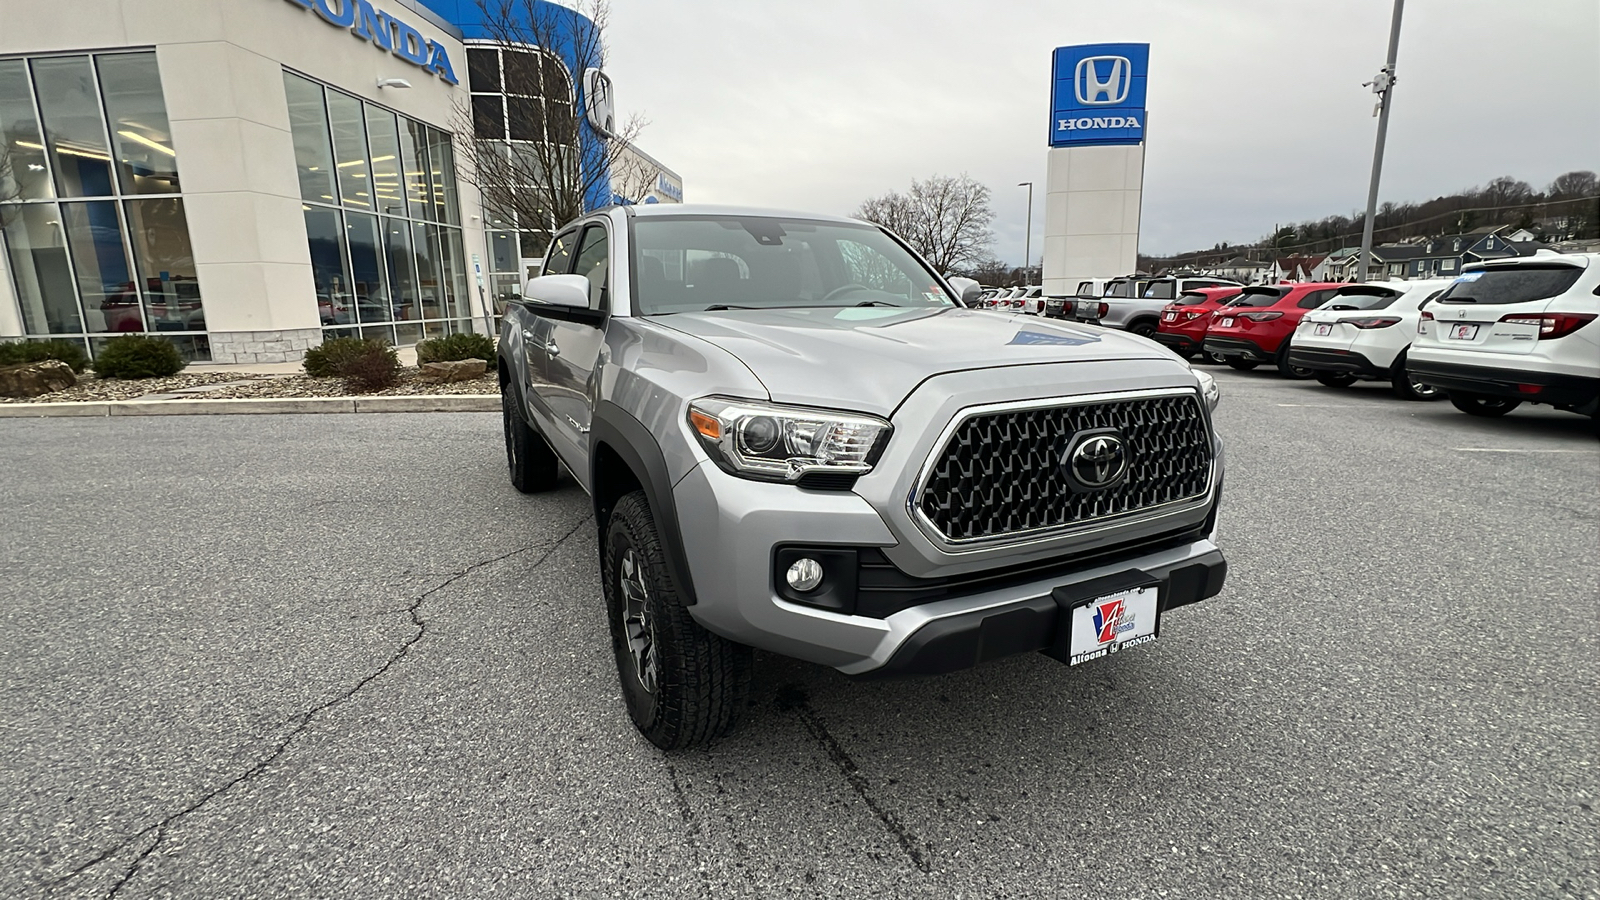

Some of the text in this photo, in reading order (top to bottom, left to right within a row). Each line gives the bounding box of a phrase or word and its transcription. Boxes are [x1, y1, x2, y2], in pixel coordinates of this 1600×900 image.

[284, 0, 459, 86] ONDA
[1058, 117, 1142, 131] HONDA
[1070, 634, 1157, 666] Altoona HONDA
